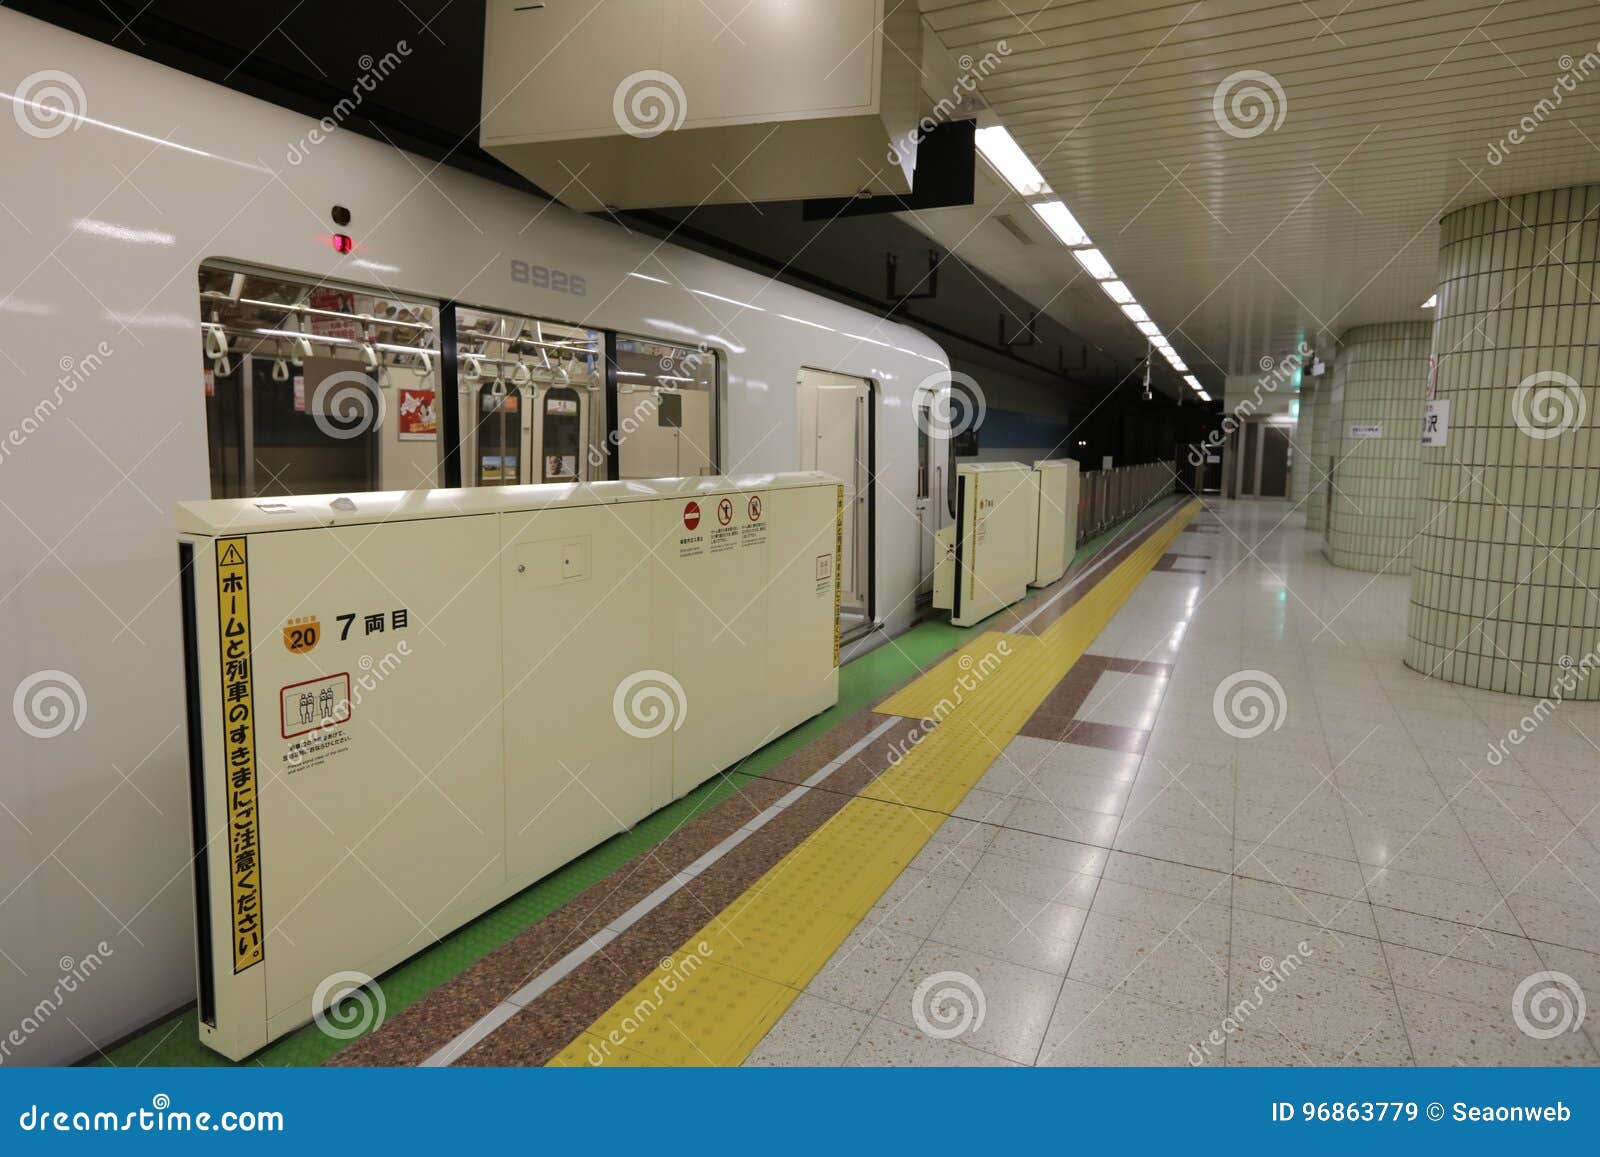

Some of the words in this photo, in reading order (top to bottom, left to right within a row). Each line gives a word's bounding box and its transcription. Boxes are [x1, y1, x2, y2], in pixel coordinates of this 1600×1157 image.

[511, 259, 586, 297] 8926
[290, 627, 316, 650] 20
[335, 608, 408, 641] 7両目
[222, 572, 259, 957] ホームと列車のすきまにご注意ください。
